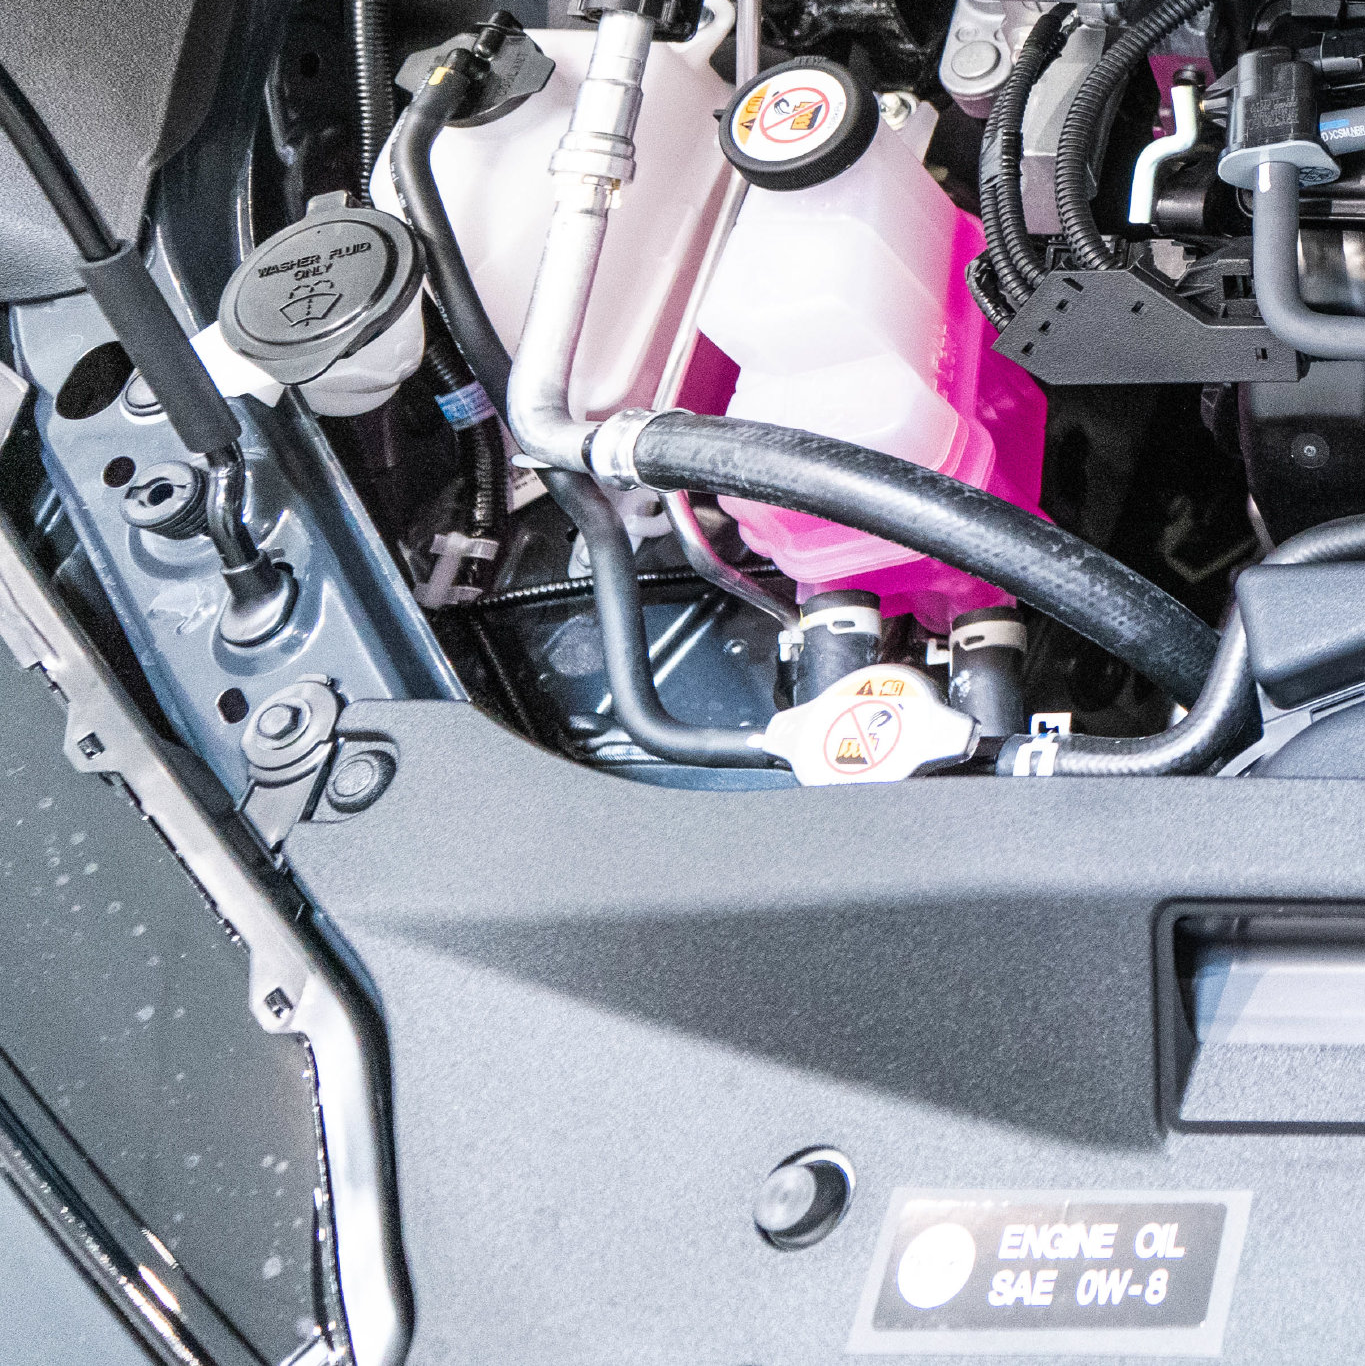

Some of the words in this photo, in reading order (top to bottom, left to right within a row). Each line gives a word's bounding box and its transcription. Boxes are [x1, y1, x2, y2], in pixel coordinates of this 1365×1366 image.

[258, 254, 320, 279] WASHER
[328, 241, 372, 260] FLUID
[293, 263, 333, 282] ONLY
[998, 1222, 1119, 1260] ENGINE
[1134, 1222, 1187, 1260] OIL
[987, 1268, 1059, 1307] SAE
